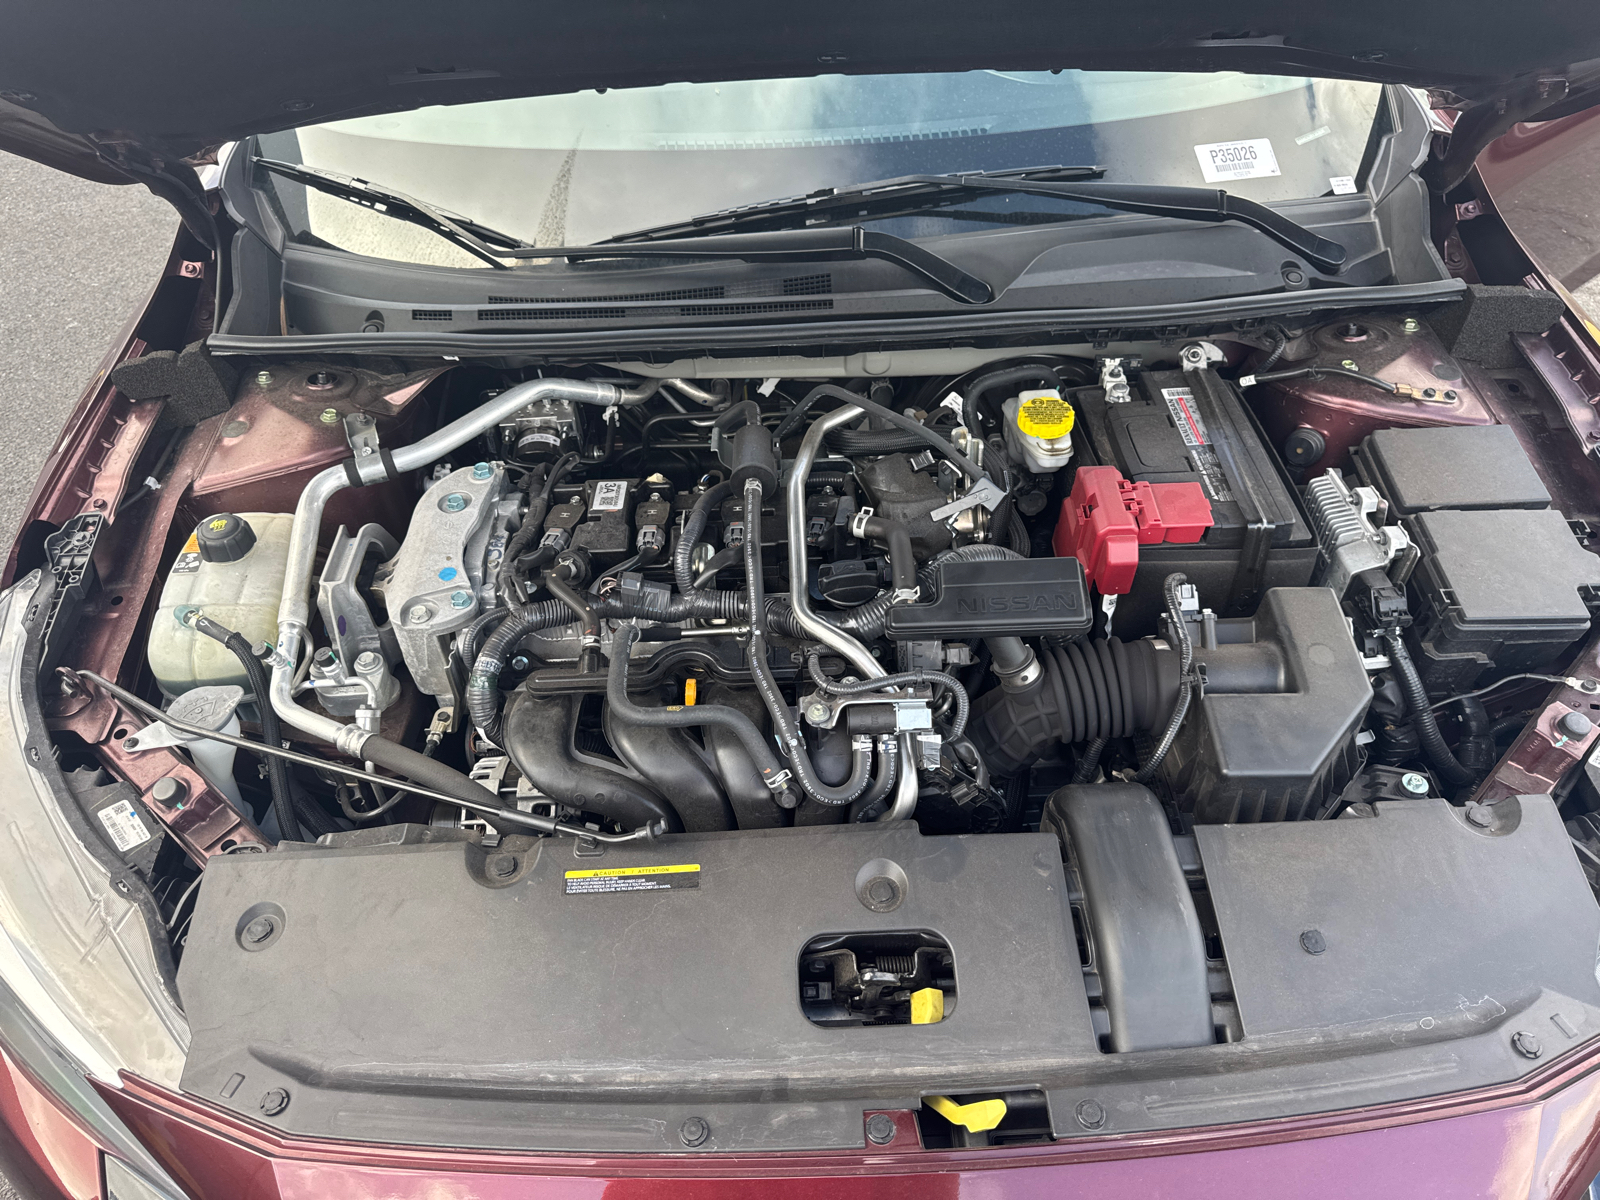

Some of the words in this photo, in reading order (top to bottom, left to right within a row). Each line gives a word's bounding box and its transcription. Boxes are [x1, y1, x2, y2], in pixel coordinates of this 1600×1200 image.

[1210, 146, 1258, 164] P35026
[1166, 398, 1183, 421] NISSAN
[1177, 422, 1193, 444] RENAULT
[604, 482, 616, 494] 3A
[957, 594, 1078, 614] NISSAN
